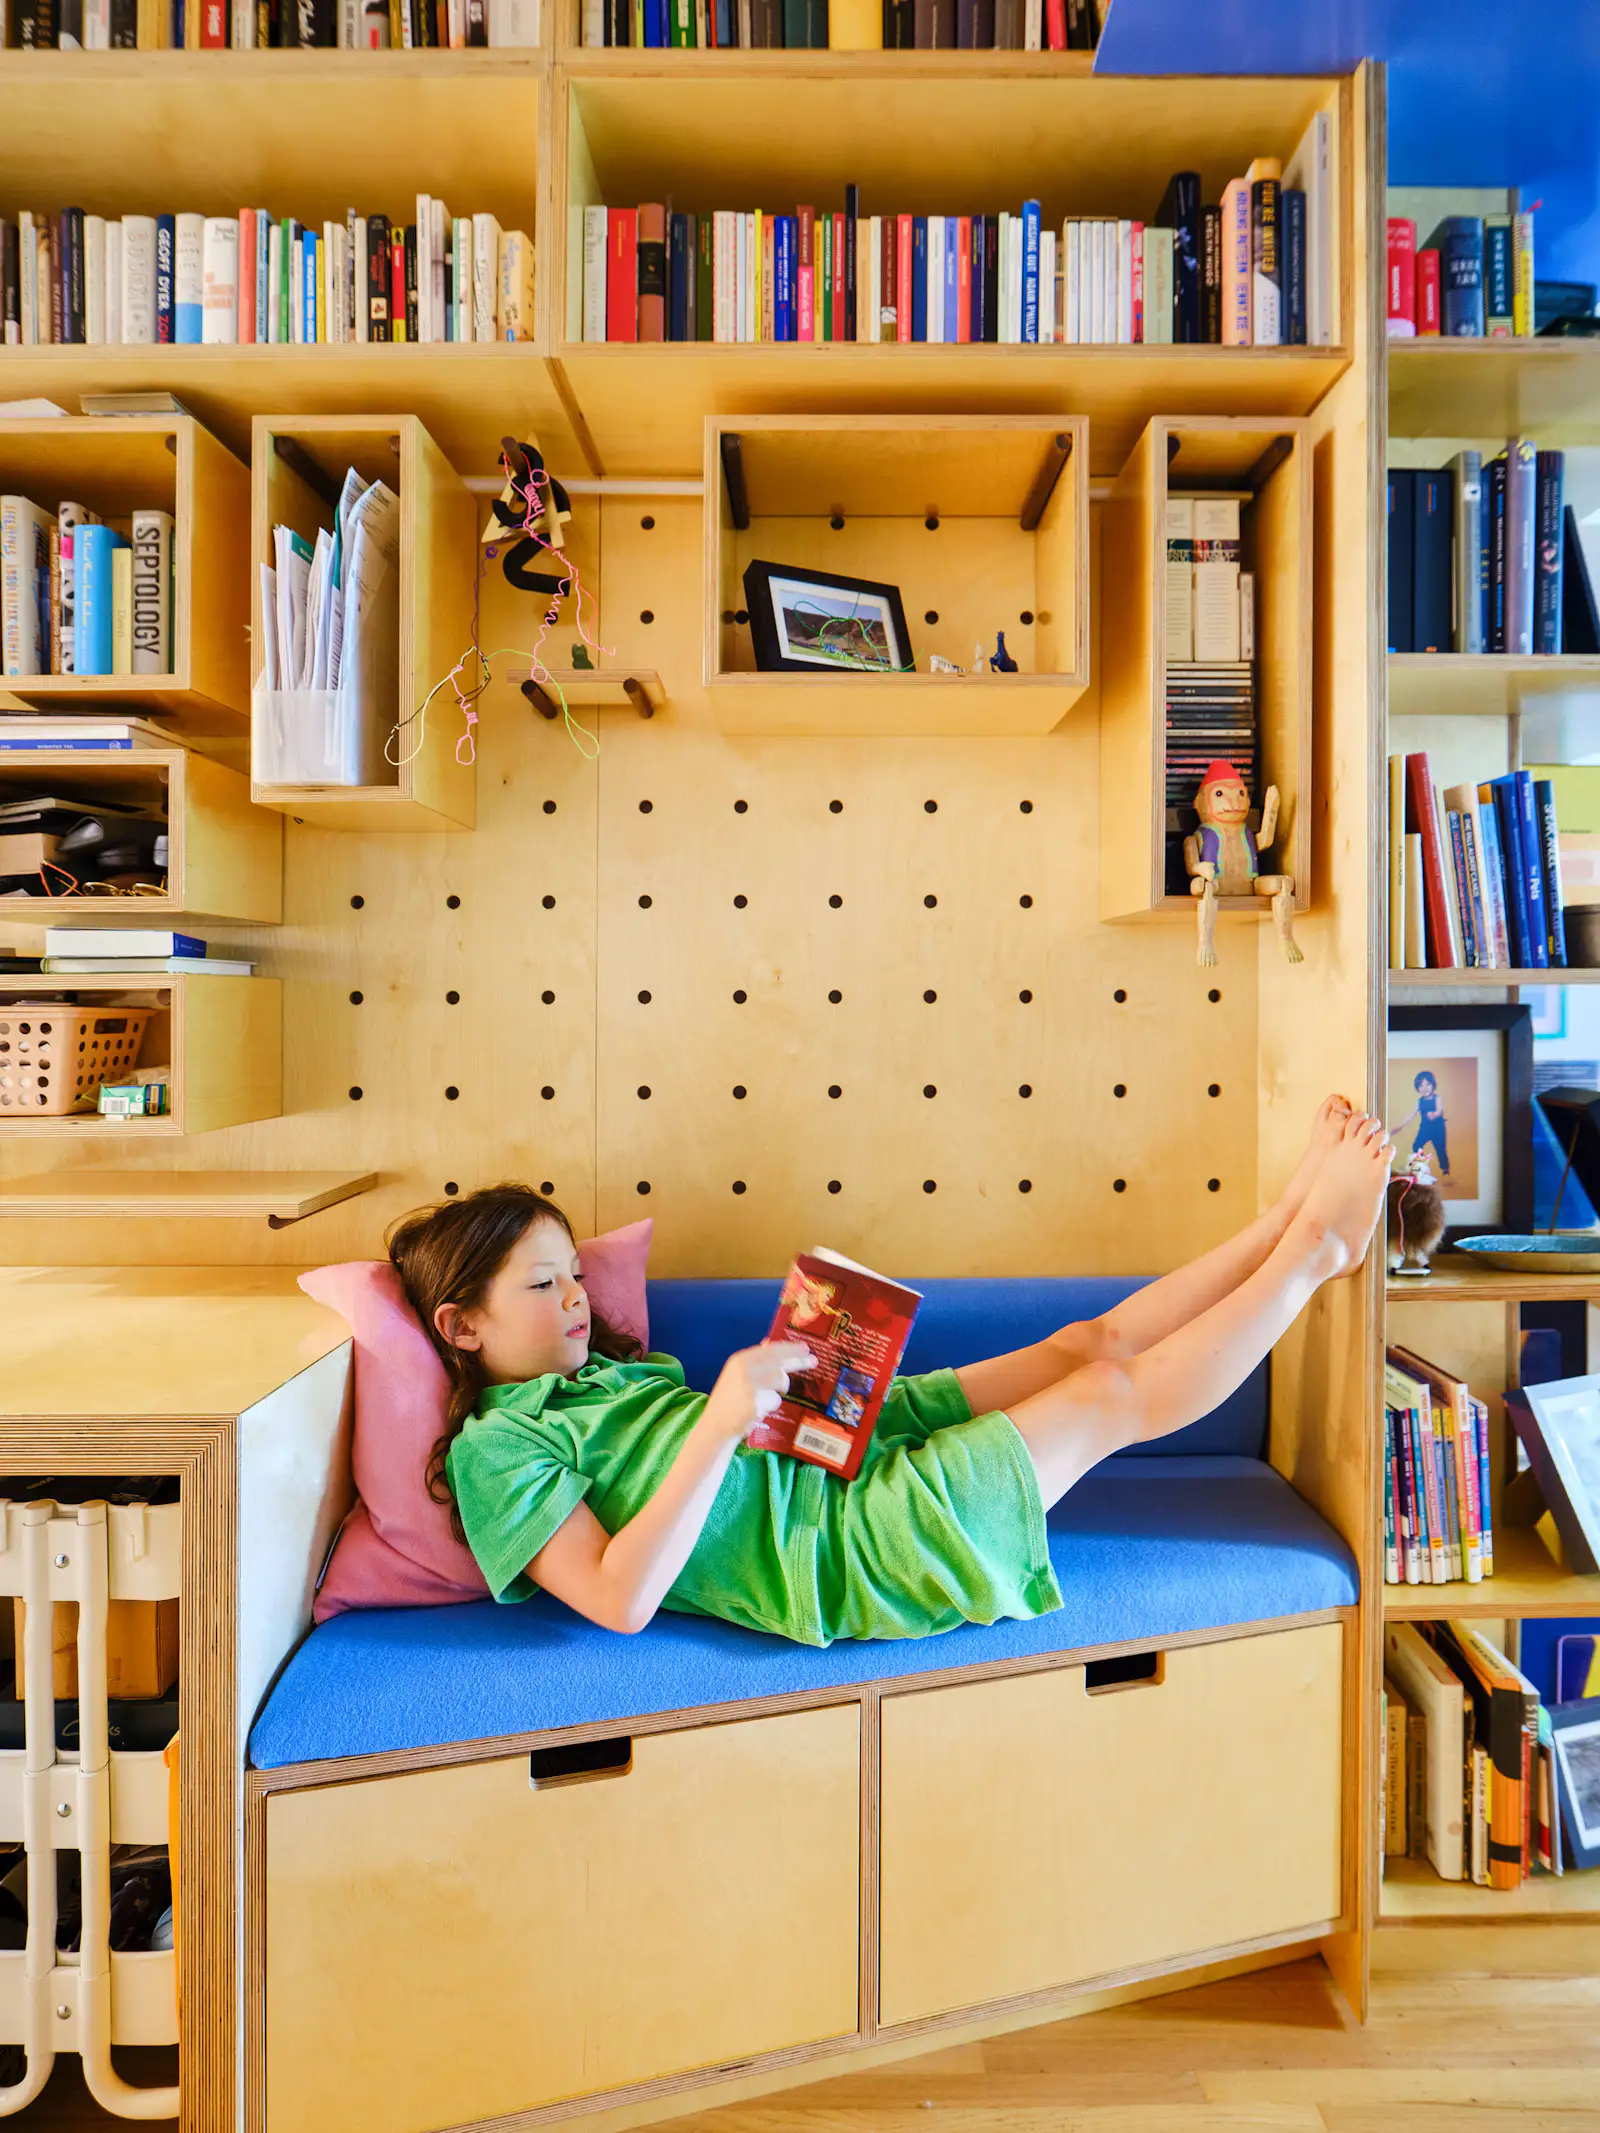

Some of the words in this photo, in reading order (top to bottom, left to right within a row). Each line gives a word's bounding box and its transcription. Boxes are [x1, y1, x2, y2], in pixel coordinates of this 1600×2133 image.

[1236, 191, 1248, 230] HOLDING
[158, 228, 171, 273] GEOFF
[1026, 213, 1037, 253] MISSING
[1205, 214, 1214, 254] EVELYN
[1262, 225, 1275, 273] INVITED
[1026, 253, 1037, 273] OUT
[1205, 256, 1214, 287] HUGO
[158, 275, 171, 312] DYER
[1026, 276, 1036, 304] ADAM
[134, 526, 160, 655] SEPTOLOGY
[1529, 877, 1541, 901] Pets
